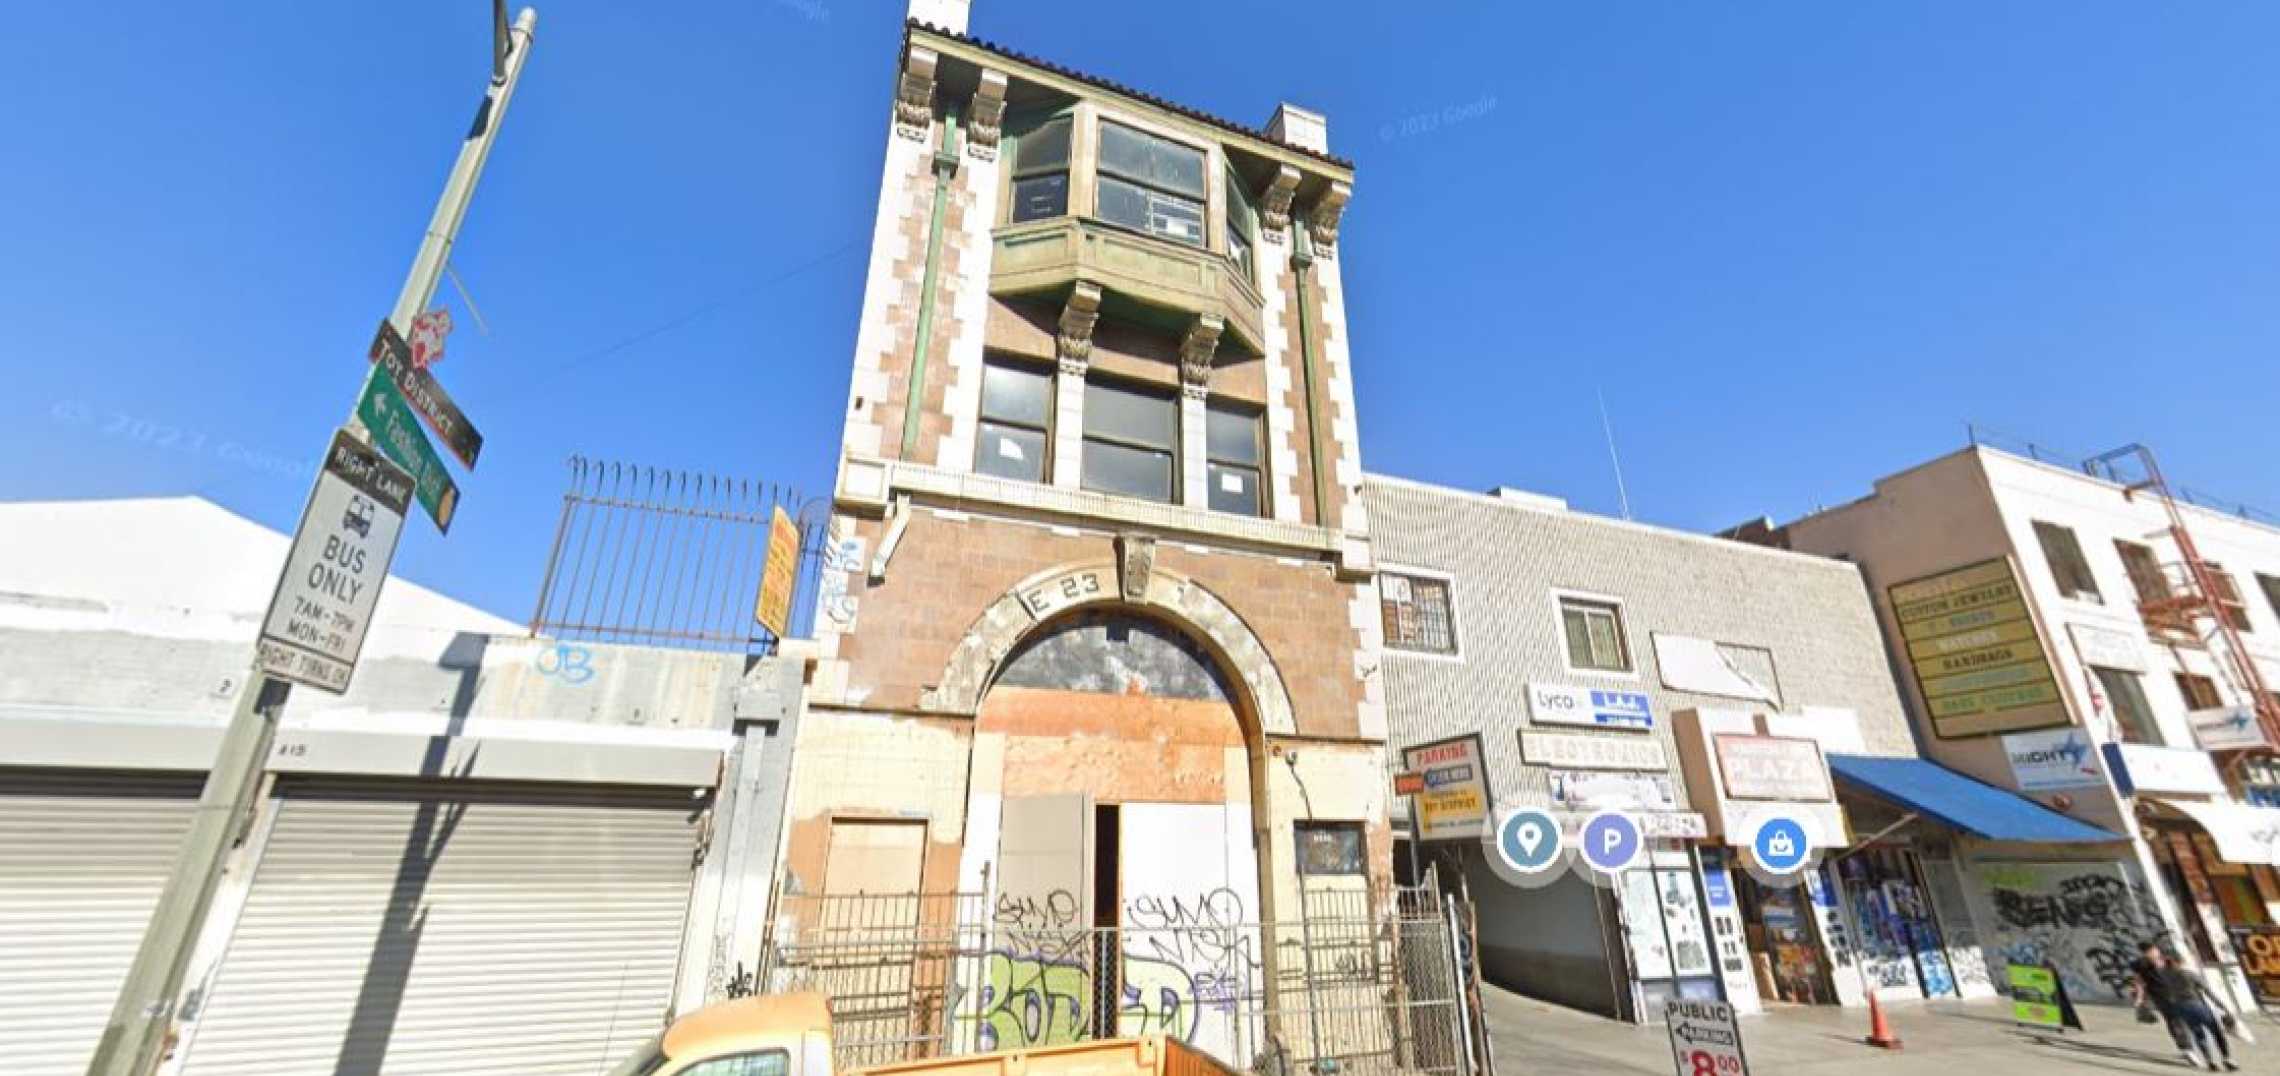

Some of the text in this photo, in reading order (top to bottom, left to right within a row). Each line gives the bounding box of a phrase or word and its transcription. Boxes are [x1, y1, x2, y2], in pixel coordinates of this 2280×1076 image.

[335, 446, 376, 483] RIGHT
[323, 534, 366, 574] BUS
[308, 562, 365, 605] ONLY
[1060, 573, 1100, 598] 23
[1416, 742, 1468, 764] PARKING
[1667, 1000, 1729, 1022] PUBLIC
